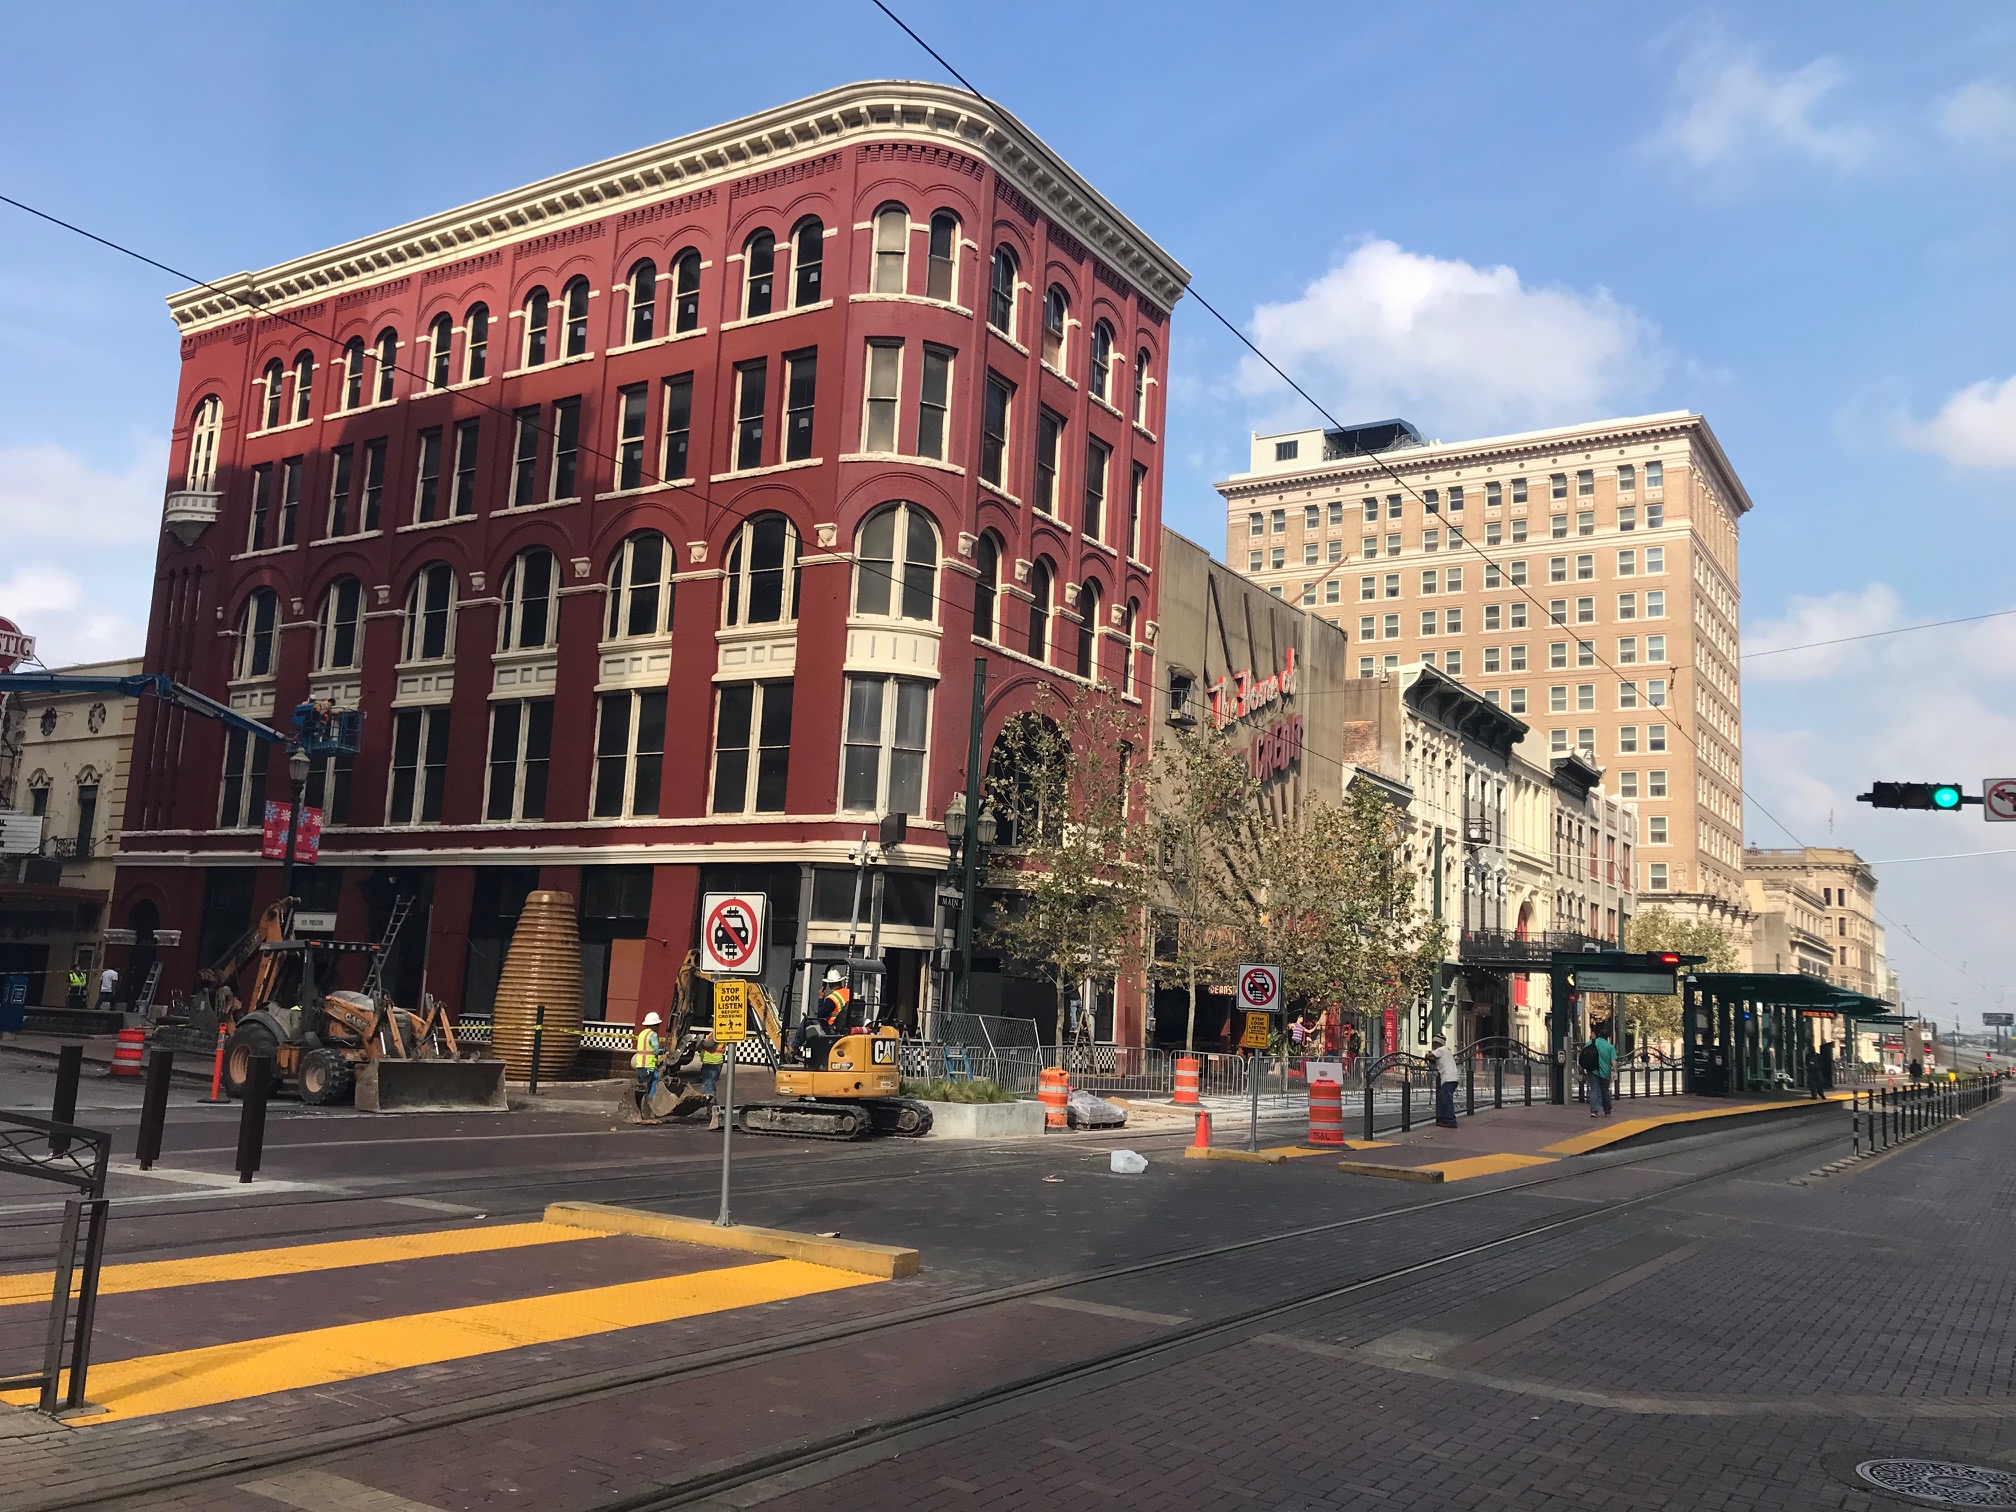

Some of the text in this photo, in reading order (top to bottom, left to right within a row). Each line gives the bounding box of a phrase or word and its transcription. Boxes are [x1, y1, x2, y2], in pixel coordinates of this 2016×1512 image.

[0, 633, 33, 657] TIC
[1206, 647, 1297, 732] The Home of
[1251, 713, 1303, 781] CREDIT
[941, 897, 959, 907] MAIN
[721, 987, 740, 995] STOP
[717, 1002, 743, 1010] LISTEN
[345, 1012, 367, 1030] CASE
[874, 1040, 896, 1064] CAT
